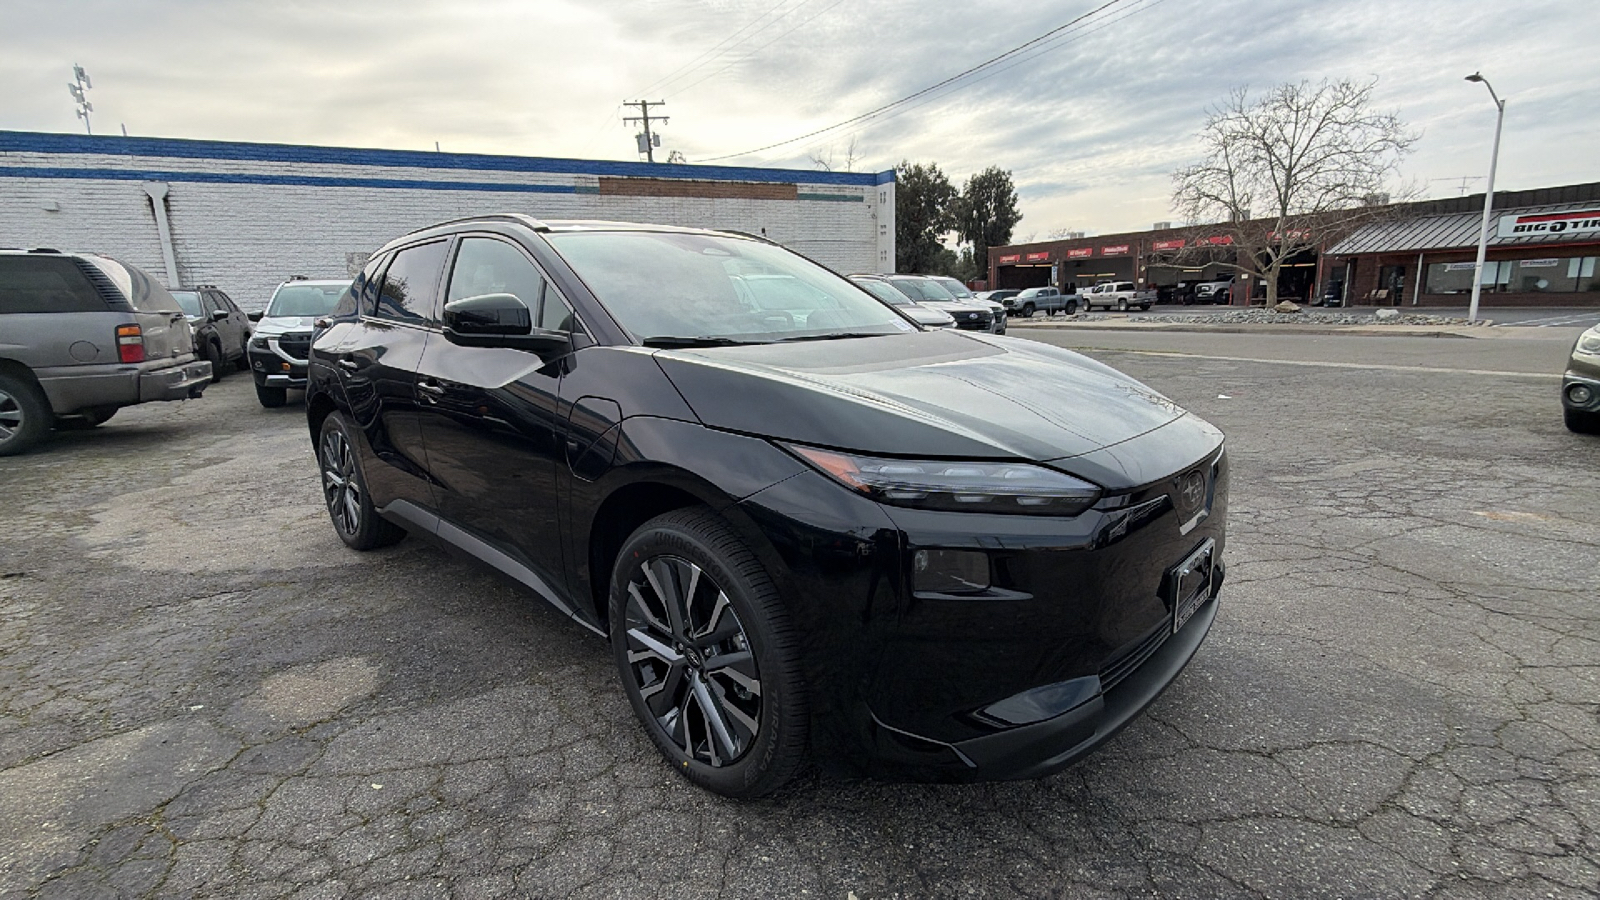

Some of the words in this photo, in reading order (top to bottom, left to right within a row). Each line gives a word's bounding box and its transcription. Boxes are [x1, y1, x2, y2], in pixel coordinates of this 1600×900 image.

[1513, 224, 1547, 233] BIG
[1550, 221, 1567, 232] O
[654, 532, 735, 595] BRIDGESTONE
[759, 689, 779, 772] TURANZA
